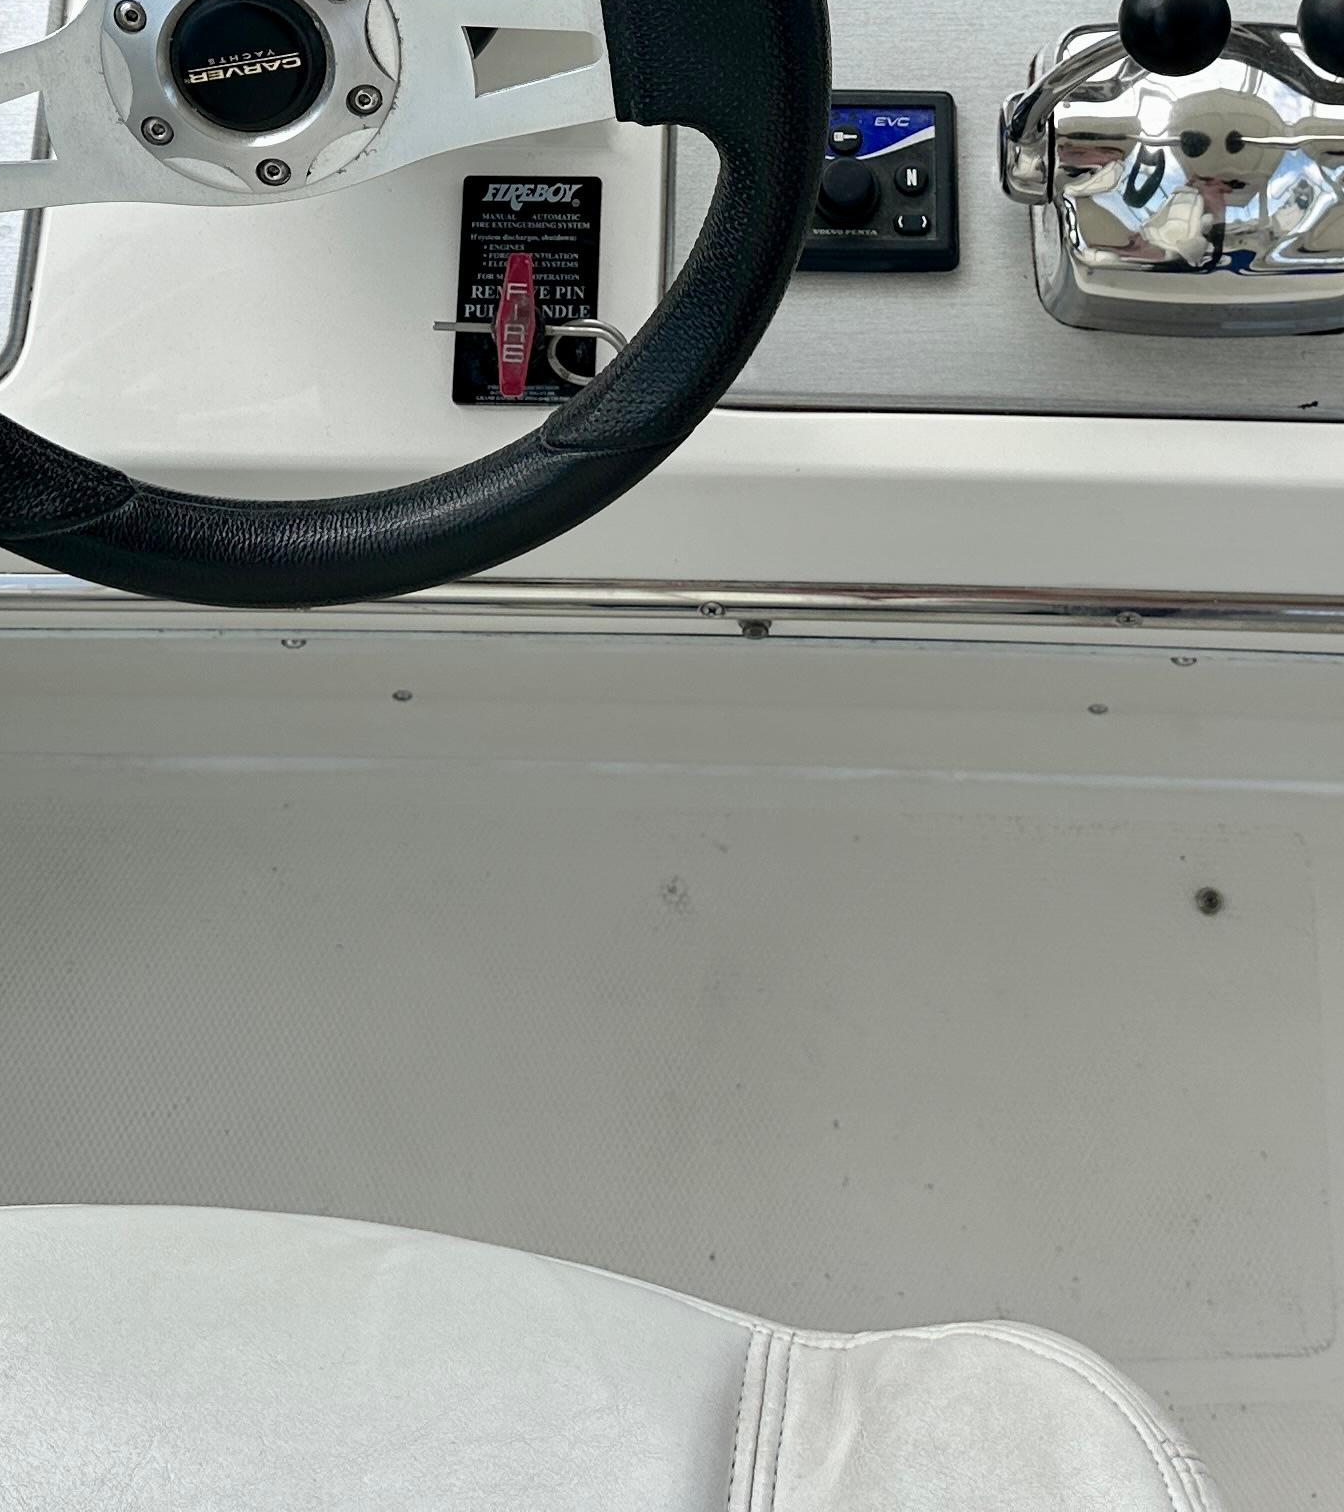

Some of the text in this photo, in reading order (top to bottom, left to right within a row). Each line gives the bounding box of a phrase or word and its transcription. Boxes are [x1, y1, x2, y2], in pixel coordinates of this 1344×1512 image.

[207, 48, 276, 66] YACHTS
[188, 56, 302, 84] CARVER
[874, 116, 910, 128] EVC
[906, 168, 919, 186] N
[481, 182, 584, 211] FIREBOY
[482, 213, 582, 222] MANUAL AUTOMATIC
[471, 221, 591, 230] FIRE EXTINGUISHING SYSTEM
[813, 228, 878, 237] VOLVO PENTA
[489, 243, 525, 251] ENGINES
[545, 260, 579, 269] SYSTEMS
[477, 273, 496, 281] FOR
[555, 285, 586, 300] PIN
[503, 282, 528, 364] FIRE
